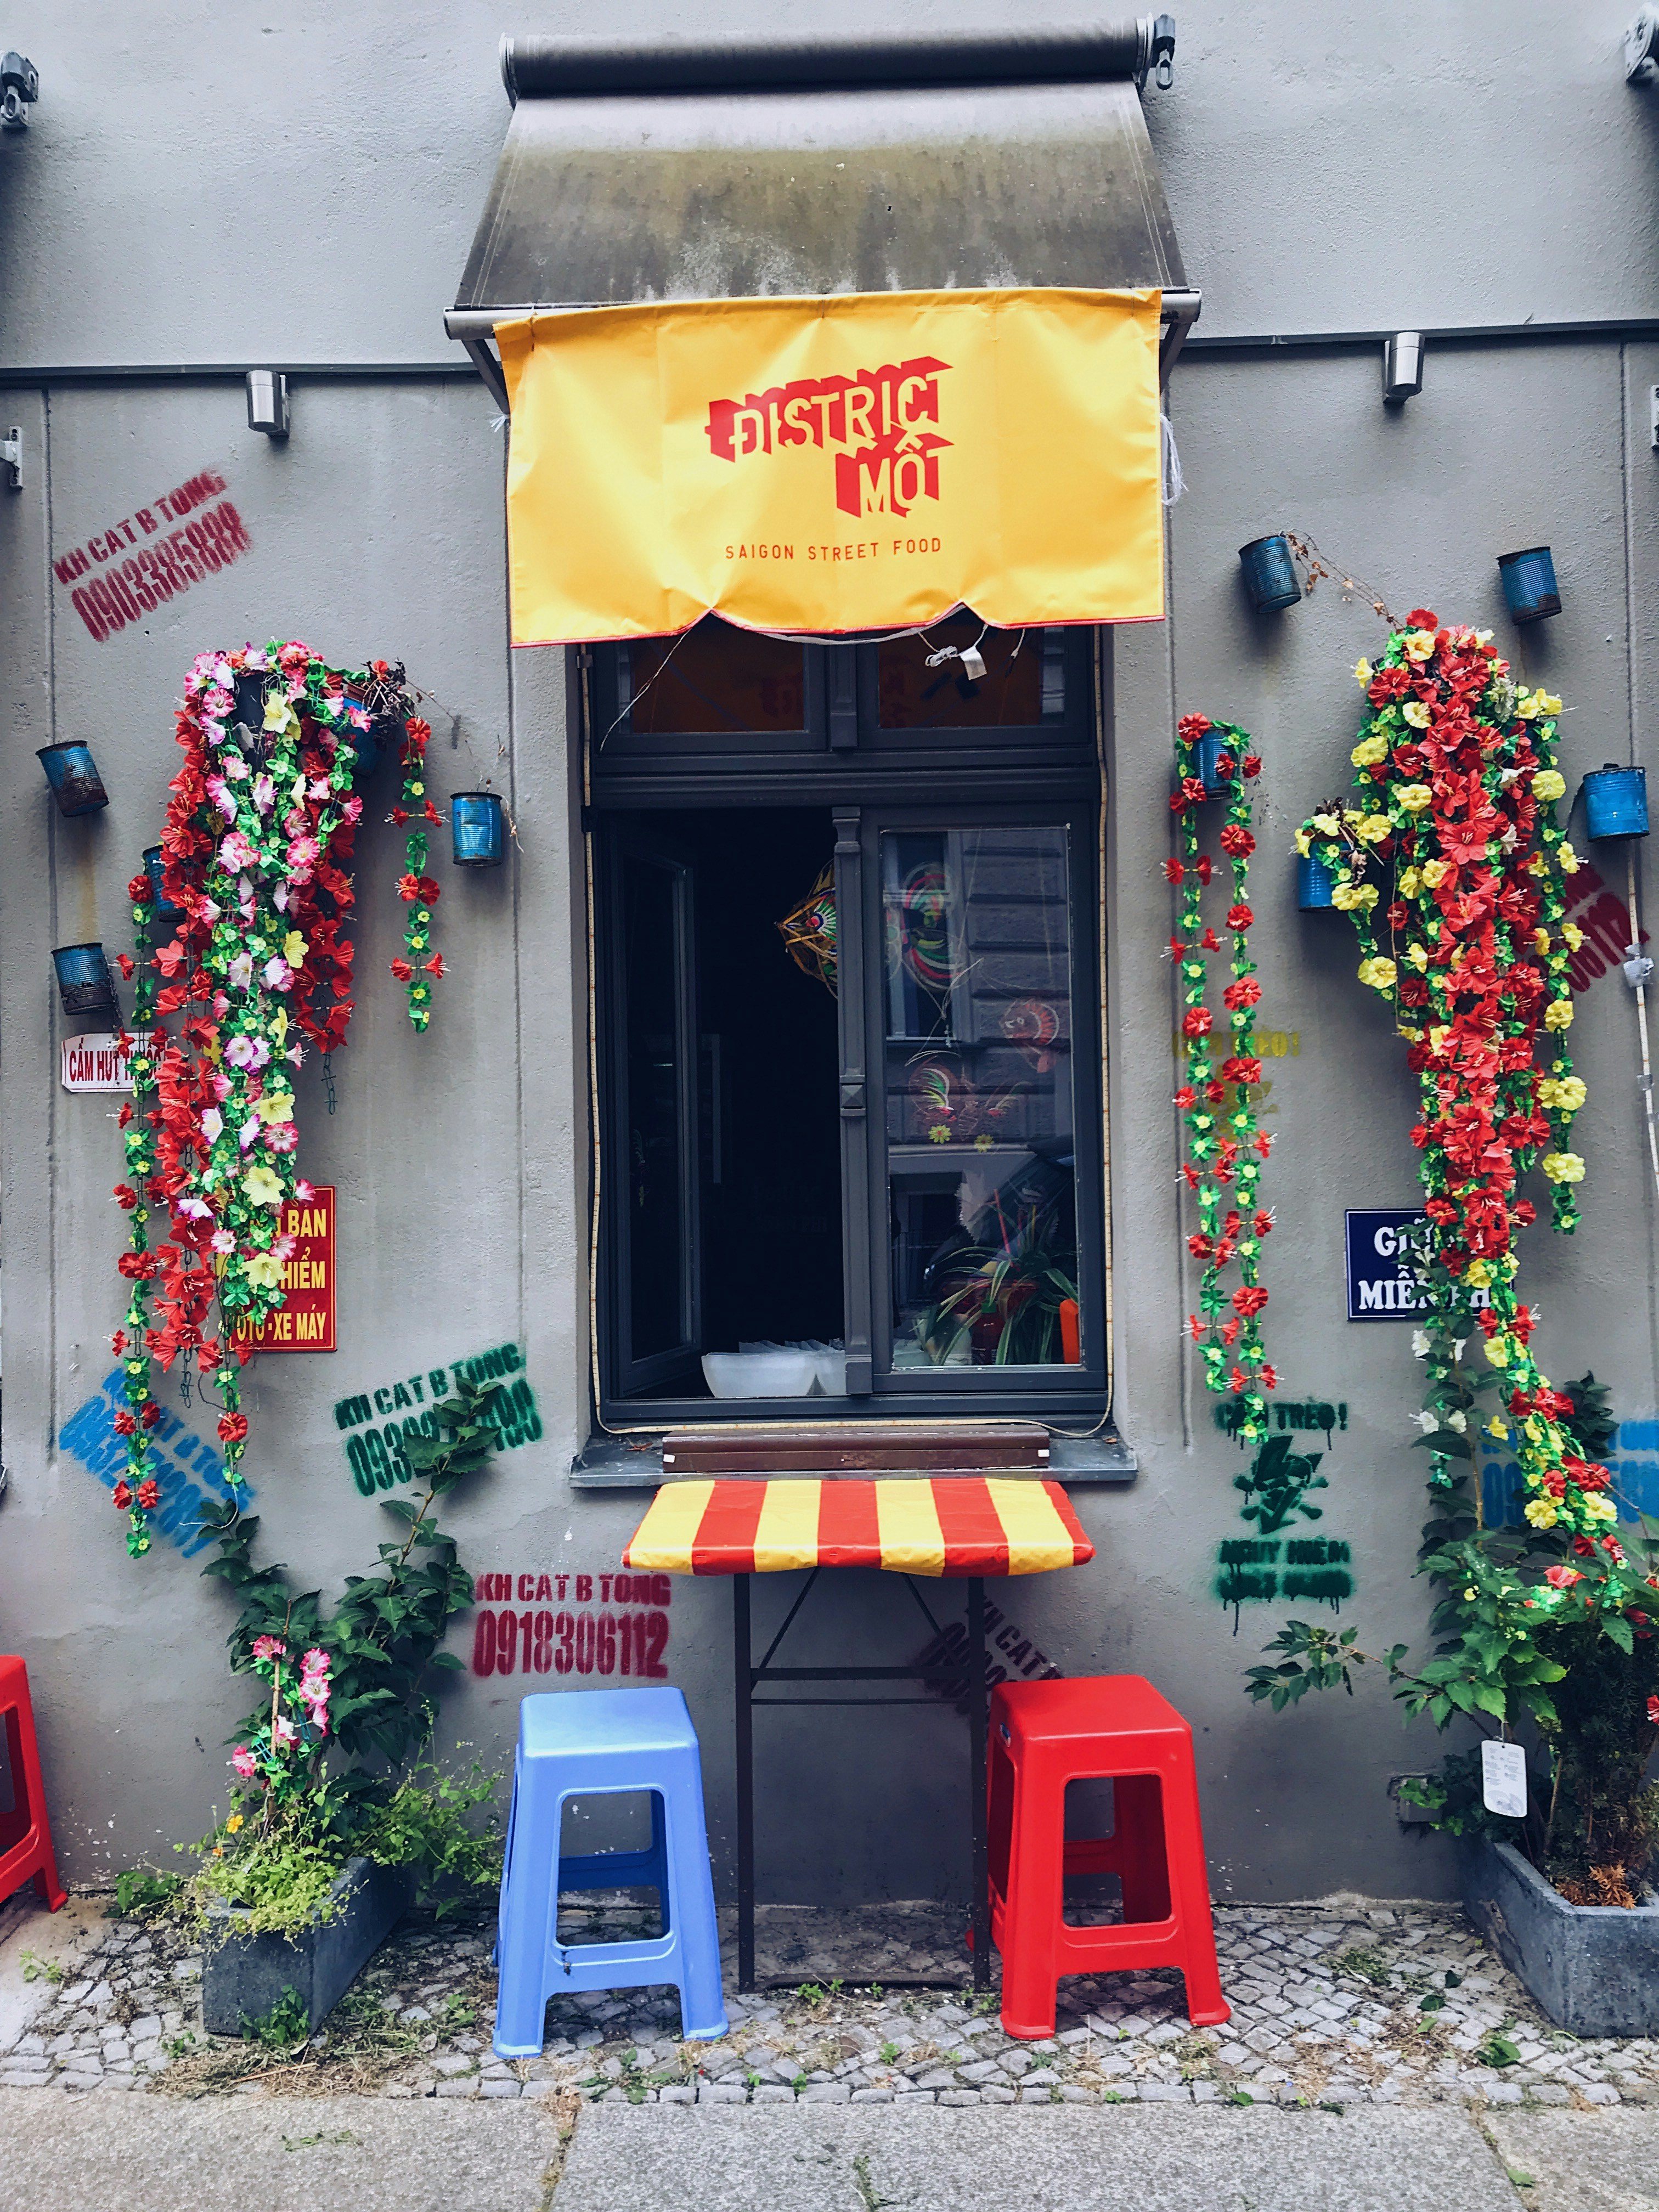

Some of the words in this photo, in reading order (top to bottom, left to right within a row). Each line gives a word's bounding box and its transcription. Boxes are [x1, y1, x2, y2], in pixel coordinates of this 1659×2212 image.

[88, 519, 137, 562] CAT
[134, 509, 158, 535] B
[726, 544, 793, 559] SAIGON
[808, 543, 879, 561] STREET
[894, 538, 940, 555] FOOD
[296, 1304, 326, 1340] MÁY
[374, 1375, 424, 1415] CAT
[428, 1369, 449, 1398] B
[476, 1573, 512, 1601] KH
[518, 1573, 569, 1601] CAT
[576, 1574, 593, 1602] B
[599, 1573, 672, 1606] TONG
[473, 1609, 670, 1678] 0918306112
[995, 1624, 1048, 1677] CAT
